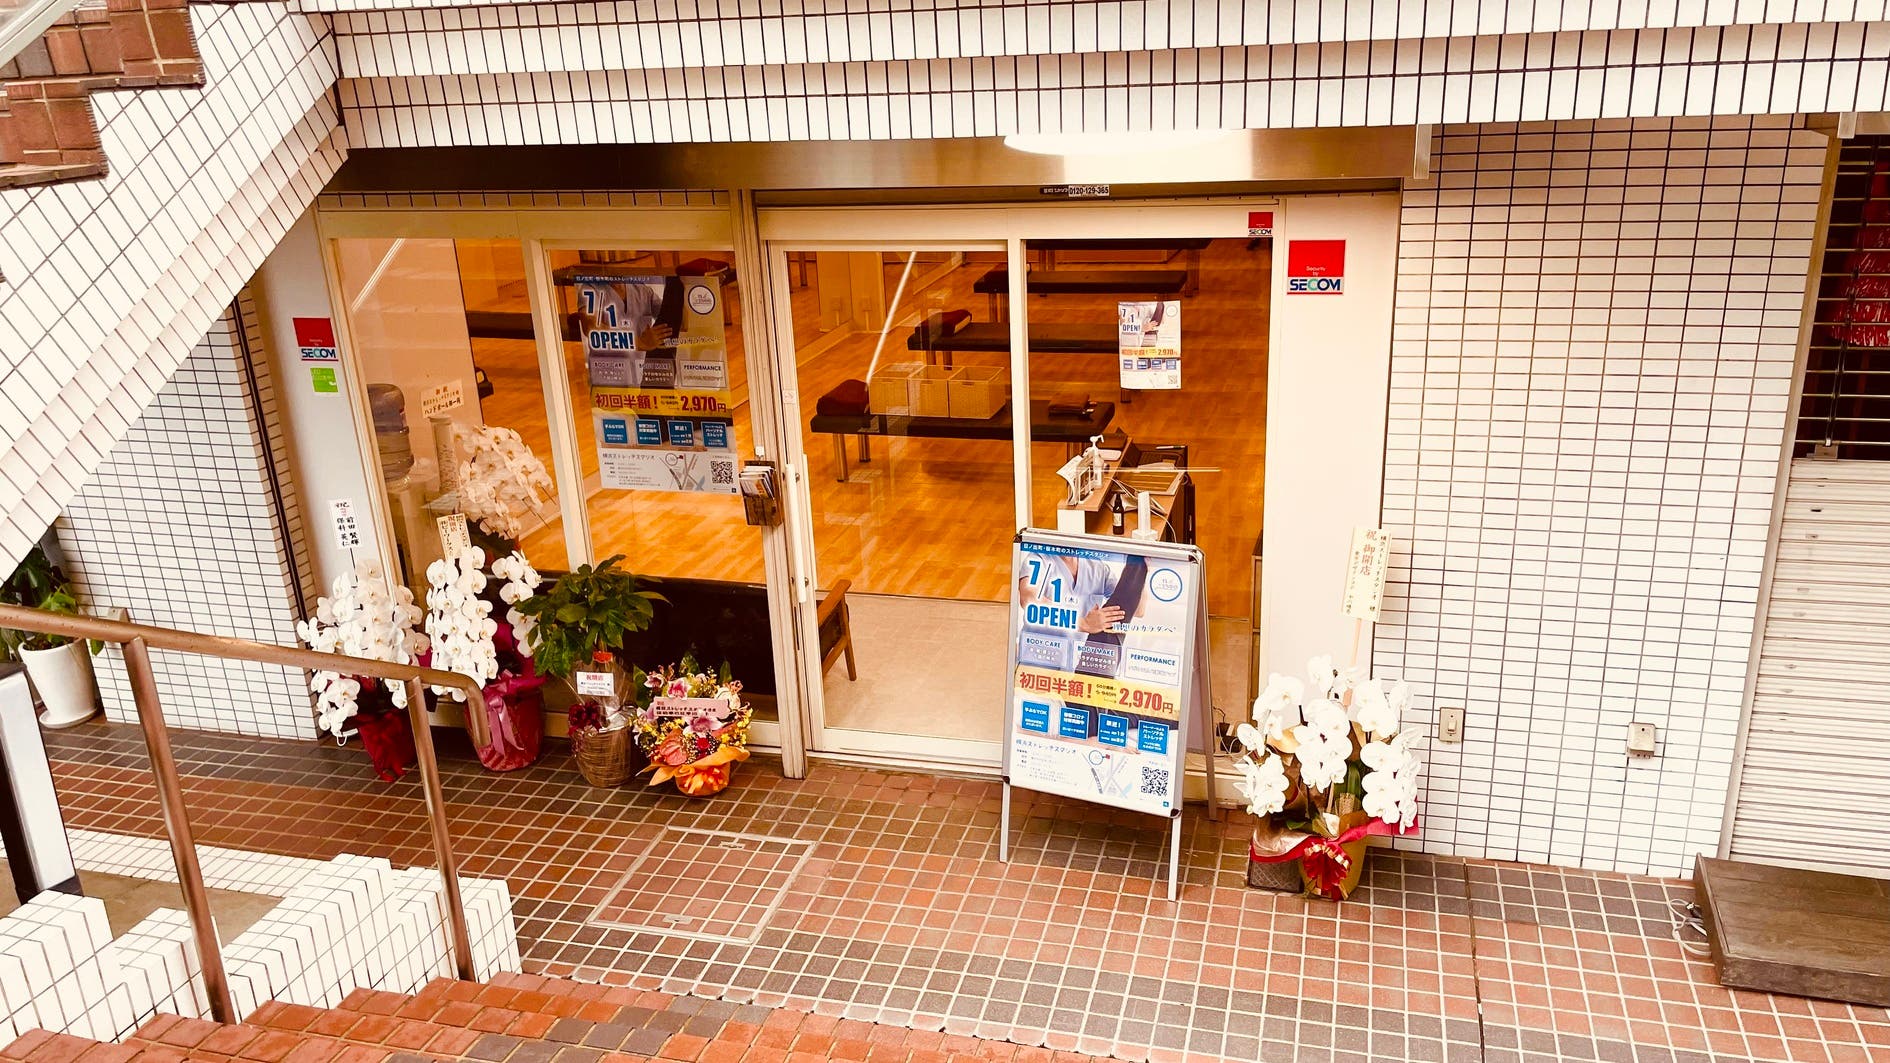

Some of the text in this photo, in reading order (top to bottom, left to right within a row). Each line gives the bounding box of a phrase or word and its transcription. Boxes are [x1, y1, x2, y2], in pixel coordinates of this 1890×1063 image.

[1289, 278, 1341, 291] SECOM
[590, 331, 635, 350] OPEN!
[301, 348, 337, 358] SECOM
[684, 364, 722, 372] PERFORMANCE
[681, 396, 727, 413] 2,970円
[1026, 604, 1078, 630] OPEN!
[1026, 637, 1062, 649] BODY CARE
[1077, 645, 1115, 657] BODY MAKE
[1130, 653, 1176, 667] PERFORMANCE
[1119, 687, 1174, 714] 2,970円
